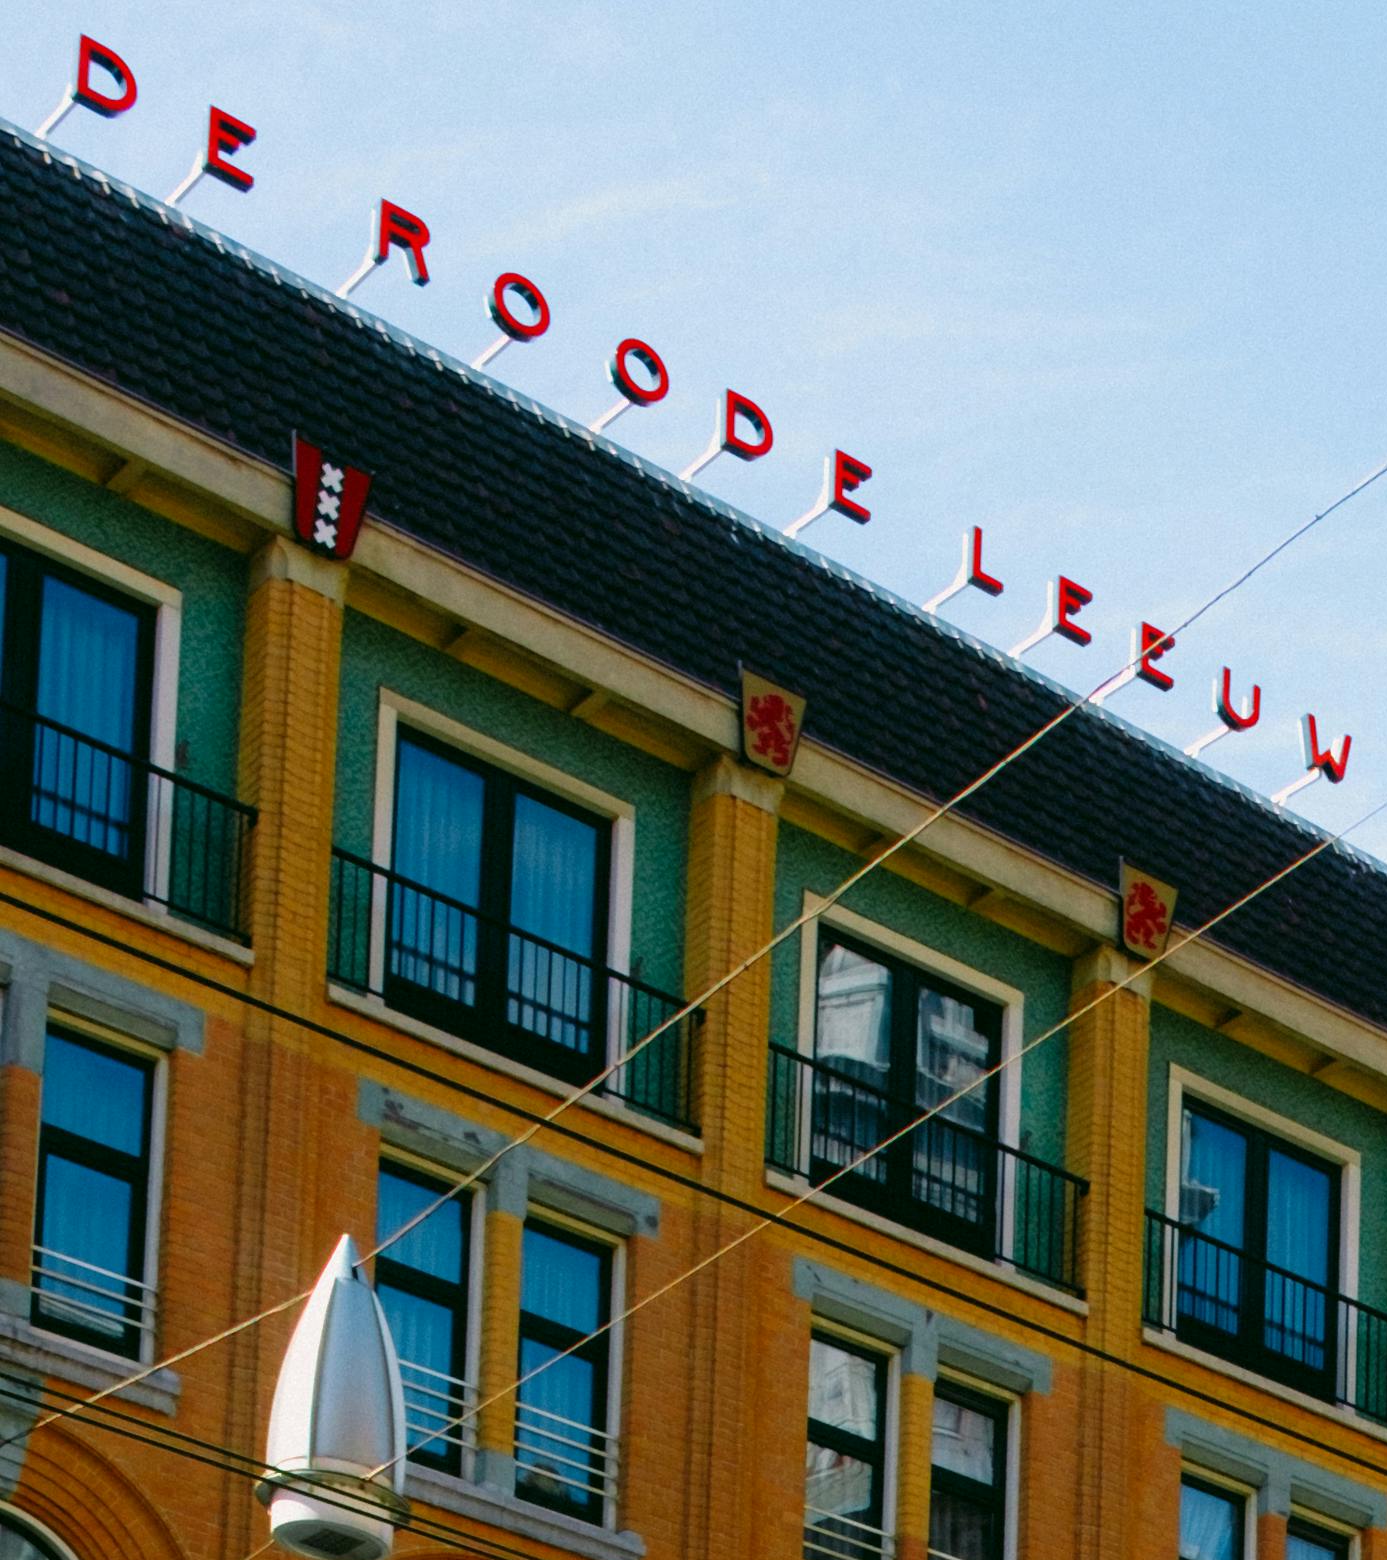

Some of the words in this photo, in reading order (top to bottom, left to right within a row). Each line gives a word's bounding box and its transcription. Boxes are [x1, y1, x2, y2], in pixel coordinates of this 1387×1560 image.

[75, 33, 257, 192] DE
[372, 198, 872, 525] ROODE
[960, 525, 1352, 784] LEEUW
